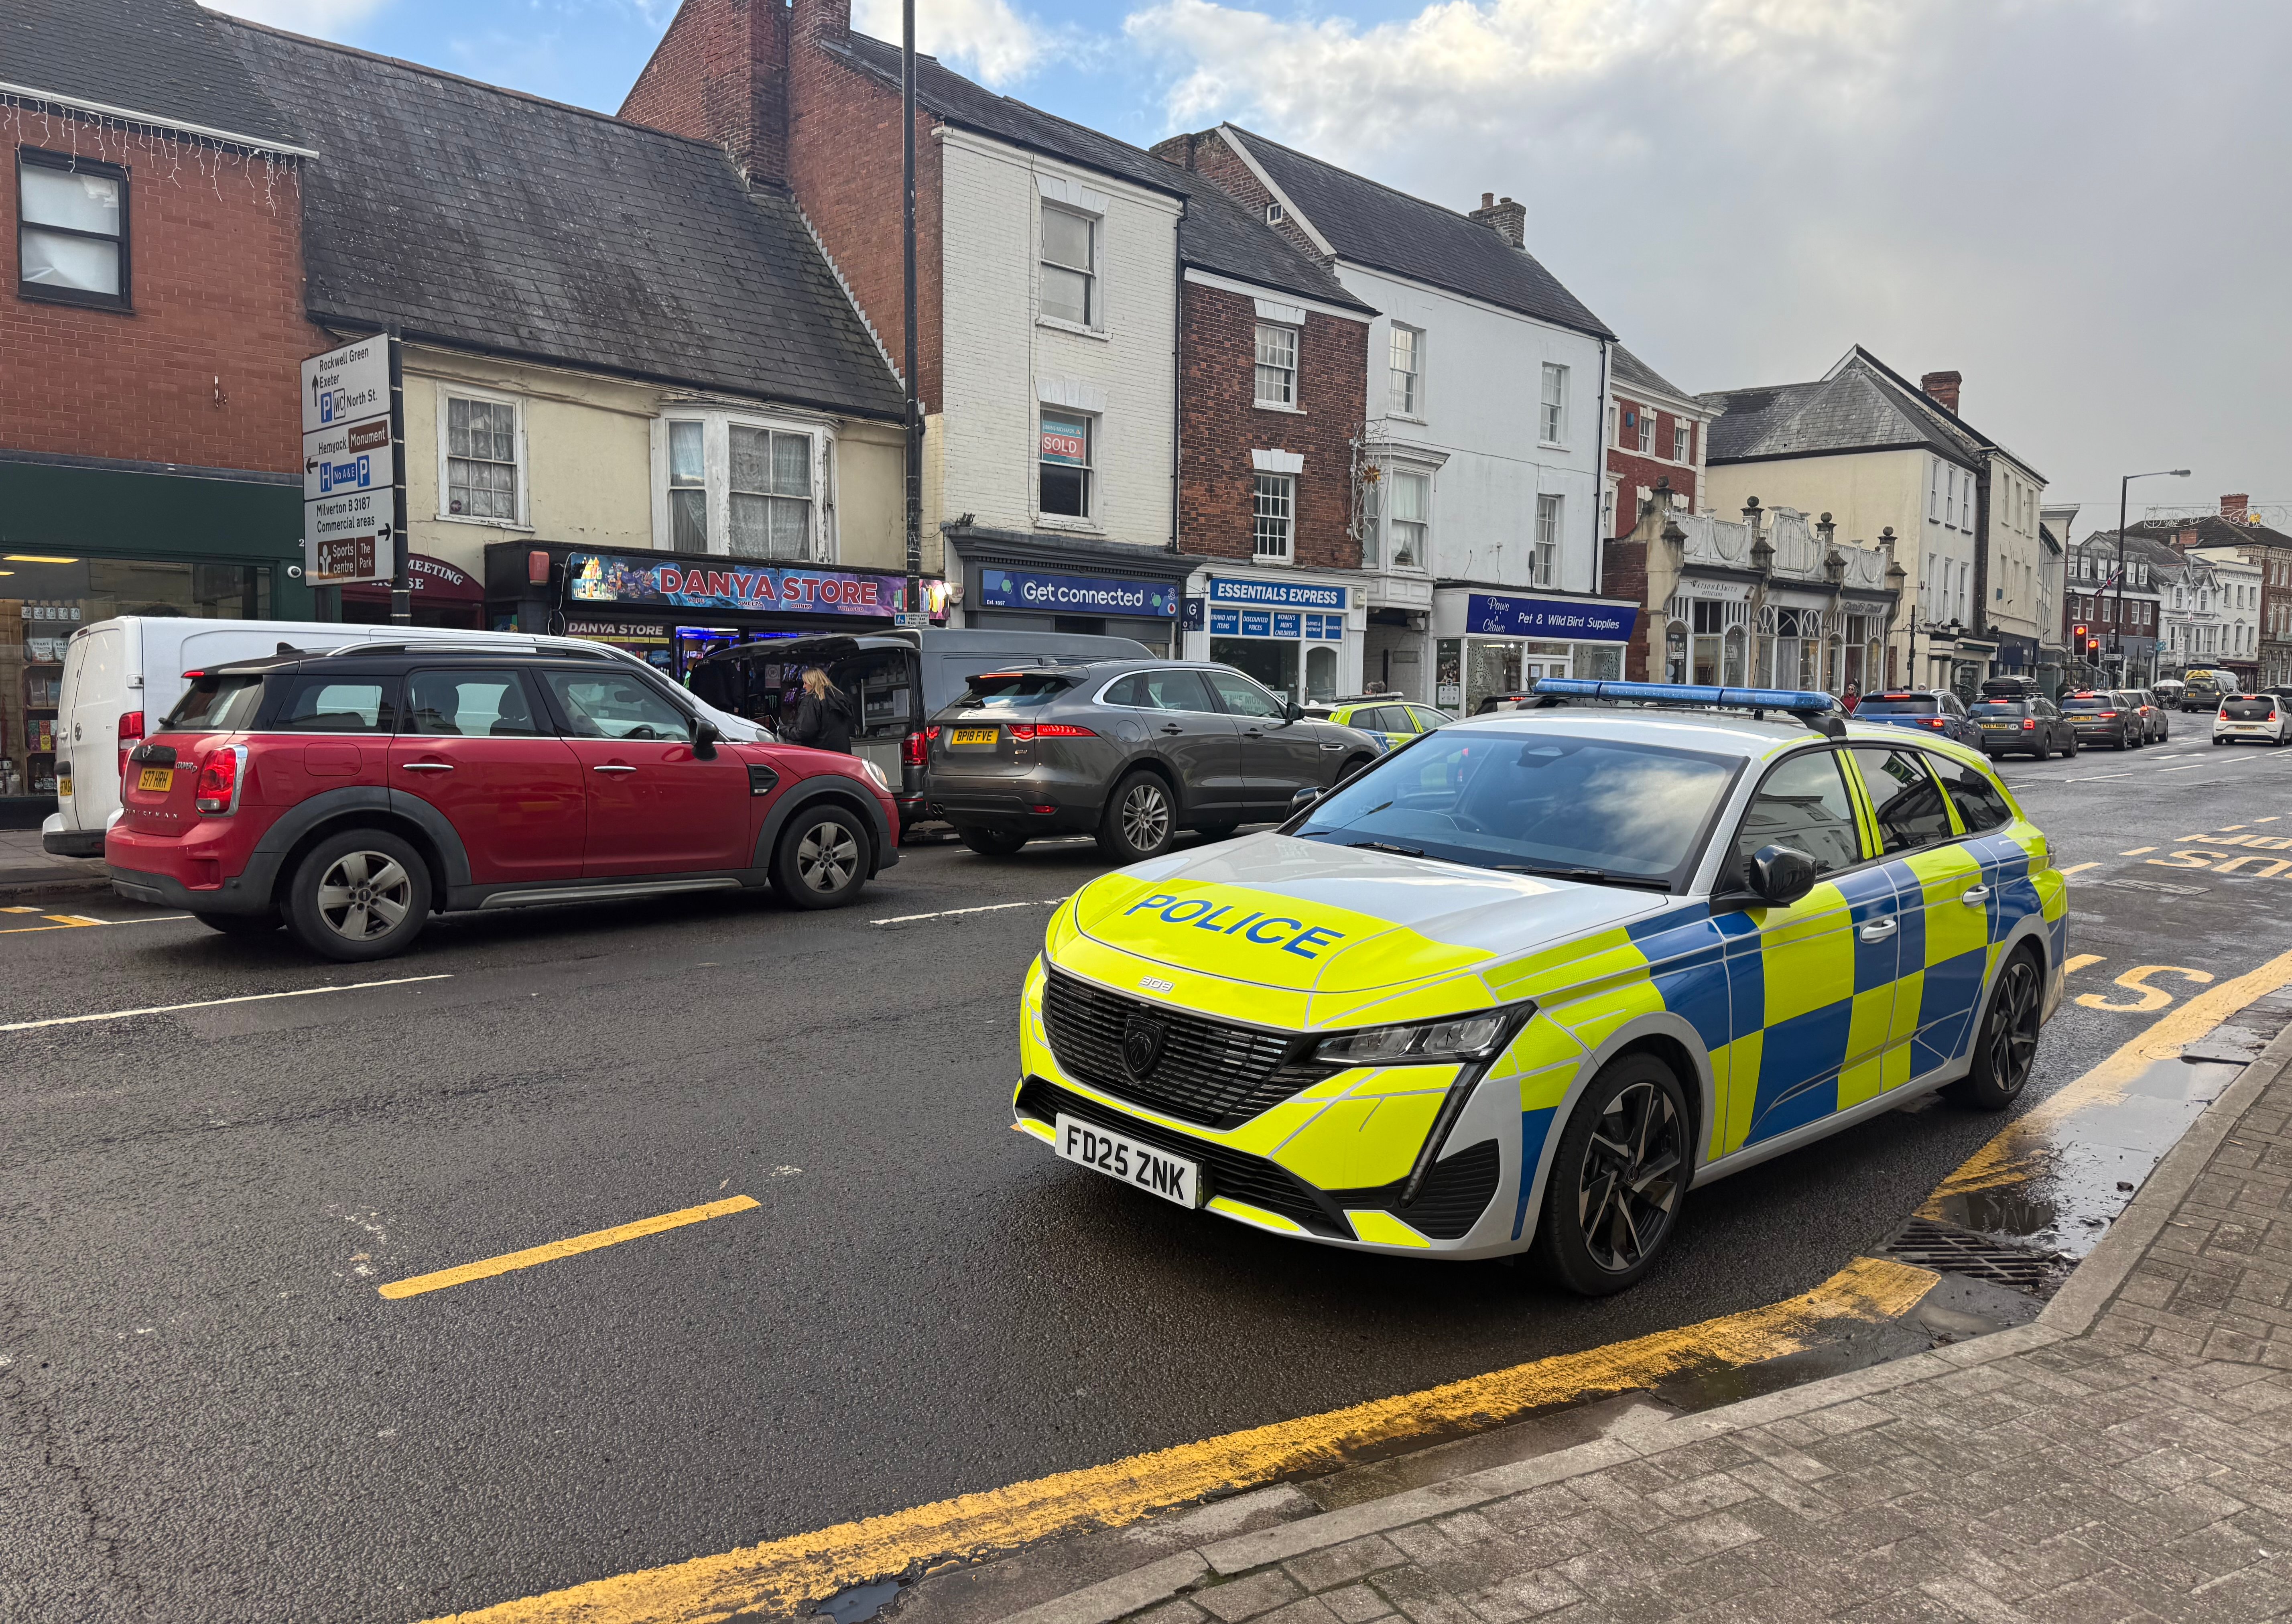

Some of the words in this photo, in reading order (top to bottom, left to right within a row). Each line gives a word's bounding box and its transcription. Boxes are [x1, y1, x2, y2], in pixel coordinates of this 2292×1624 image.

[319, 352, 347, 372] Rockwell
[349, 348, 369, 362] Green
[320, 374, 339, 389] Exeter
[323, 396, 330, 420] P
[335, 396, 344, 413] WC
[347, 391, 366, 408] North
[368, 388, 378, 402] St.
[319, 436, 347, 455] Hemyock
[350, 427, 385, 447] Monument
[1044, 437, 1077, 453] SOLD
[322, 465, 330, 489] H
[334, 470, 341, 480] No
[360, 459, 368, 484] P
[317, 502, 346, 517] Milverton
[348, 499, 353, 512] B
[354, 496, 370, 511] 3187
[317, 516, 355, 533] Commercial
[356, 516, 374, 528] areas
[333, 543, 354, 559] Sports
[360, 543, 370, 555] The
[333, 560, 354, 574] centre
[360, 557, 372, 569] Park
[659, 567, 776, 601] DANYA
[781, 577, 878, 606] STORE
[1024, 582, 1055, 602] Get
[1058, 587, 1143, 607] connected
[1217, 583, 1287, 601] ESSENTIALS
[1289, 588, 1338, 605] EXPRESS
[1487, 597, 1510, 612] Paws
[568, 623, 615, 634] DANYA
[619, 624, 664, 635] STORE
[1483, 618, 1505, 633] Claws
[1518, 612, 1533, 624] Pet
[1536, 614, 1543, 624] &
[1548, 614, 1565, 626] Wild
[1567, 616, 1585, 627] Bird
[1587, 617, 1619, 630] Supplies
[957, 731, 974, 741] BP18
[975, 731, 993, 741] FVE
[155, 771, 168, 789] HRH
[1123, 894, 1346, 959] POLICE
[1139, 976, 1173, 991] 308
[1067, 1123, 1128, 1177] FD25
[1136, 1150, 1185, 1201] ZNK
